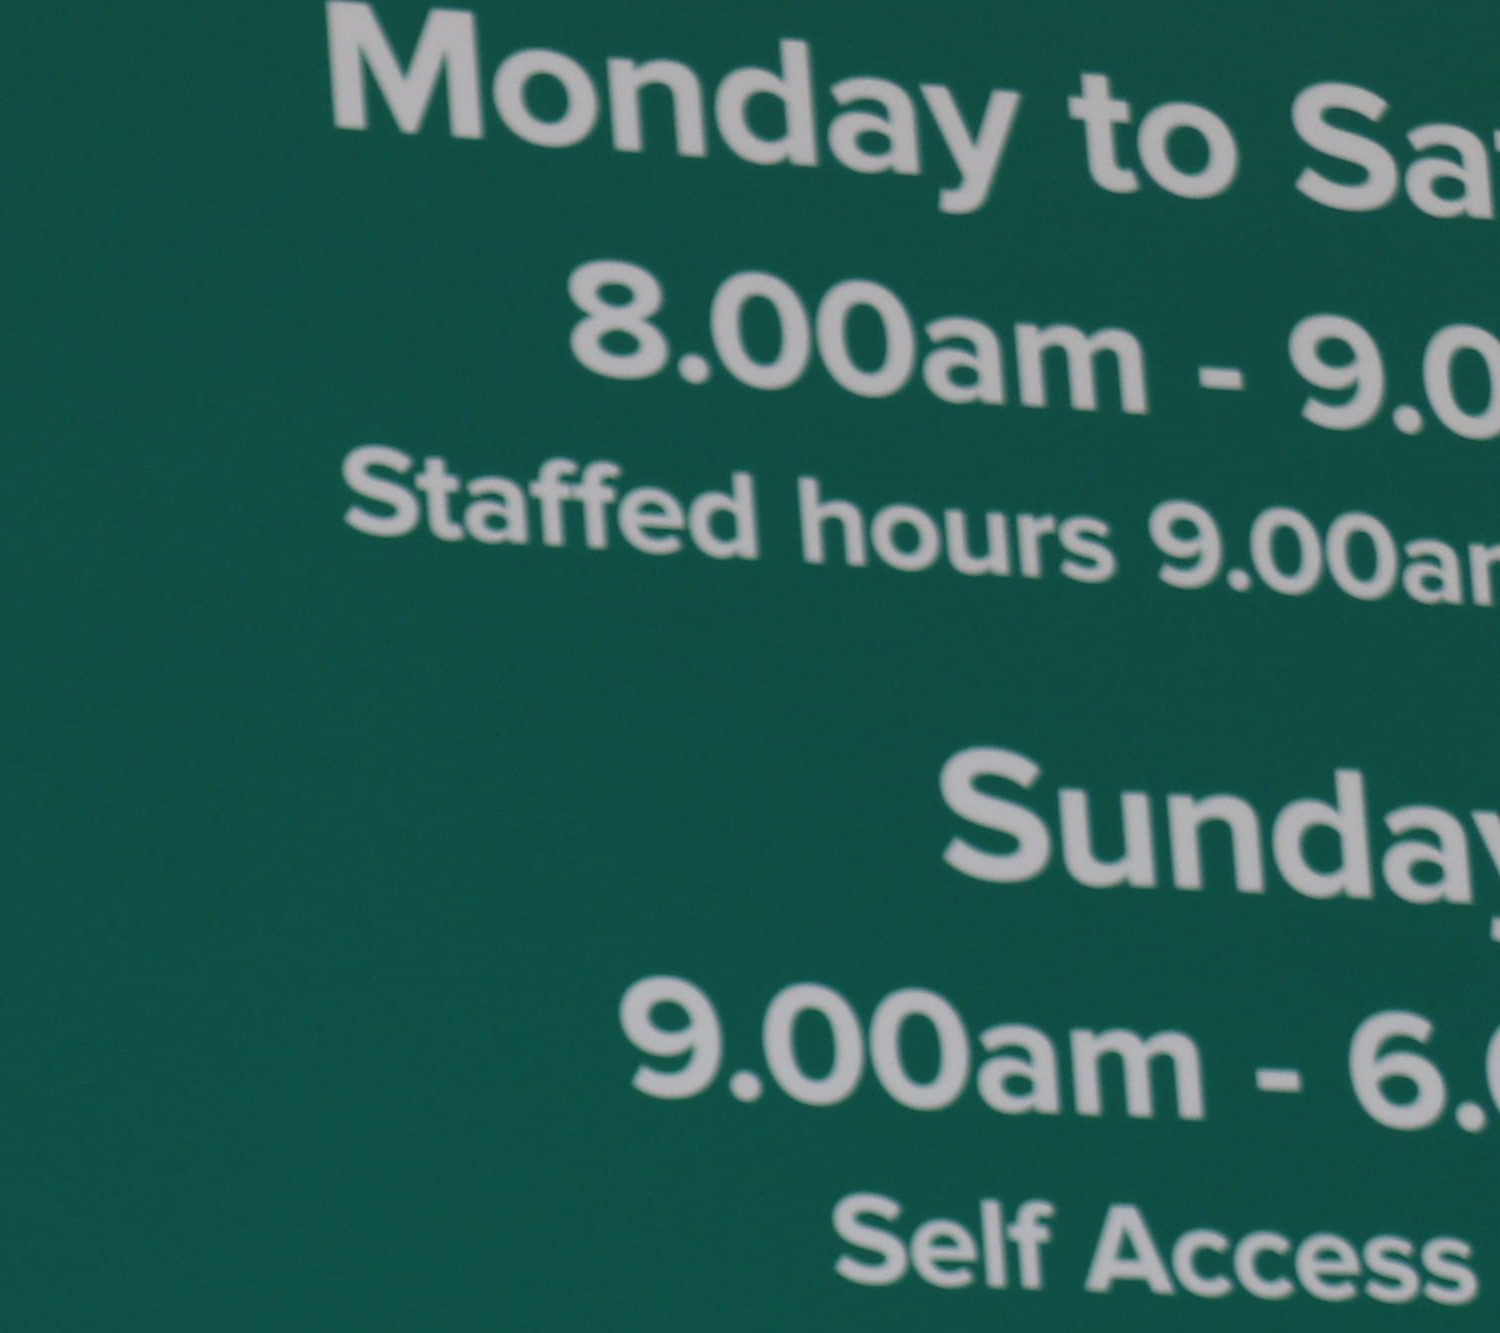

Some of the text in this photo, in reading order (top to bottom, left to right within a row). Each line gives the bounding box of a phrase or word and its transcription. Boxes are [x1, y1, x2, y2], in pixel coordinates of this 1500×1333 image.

[327, 0, 1500, 219] Monday to Sa
[569, 260, 1146, 414] 8.00am
[1199, 367, 1243, 389] -
[343, 445, 757, 559] Staffed
[799, 477, 1115, 582] hours
[620, 976, 1500, 1131] 9.00am - 6.
[833, 1193, 1478, 1304] Self Access
